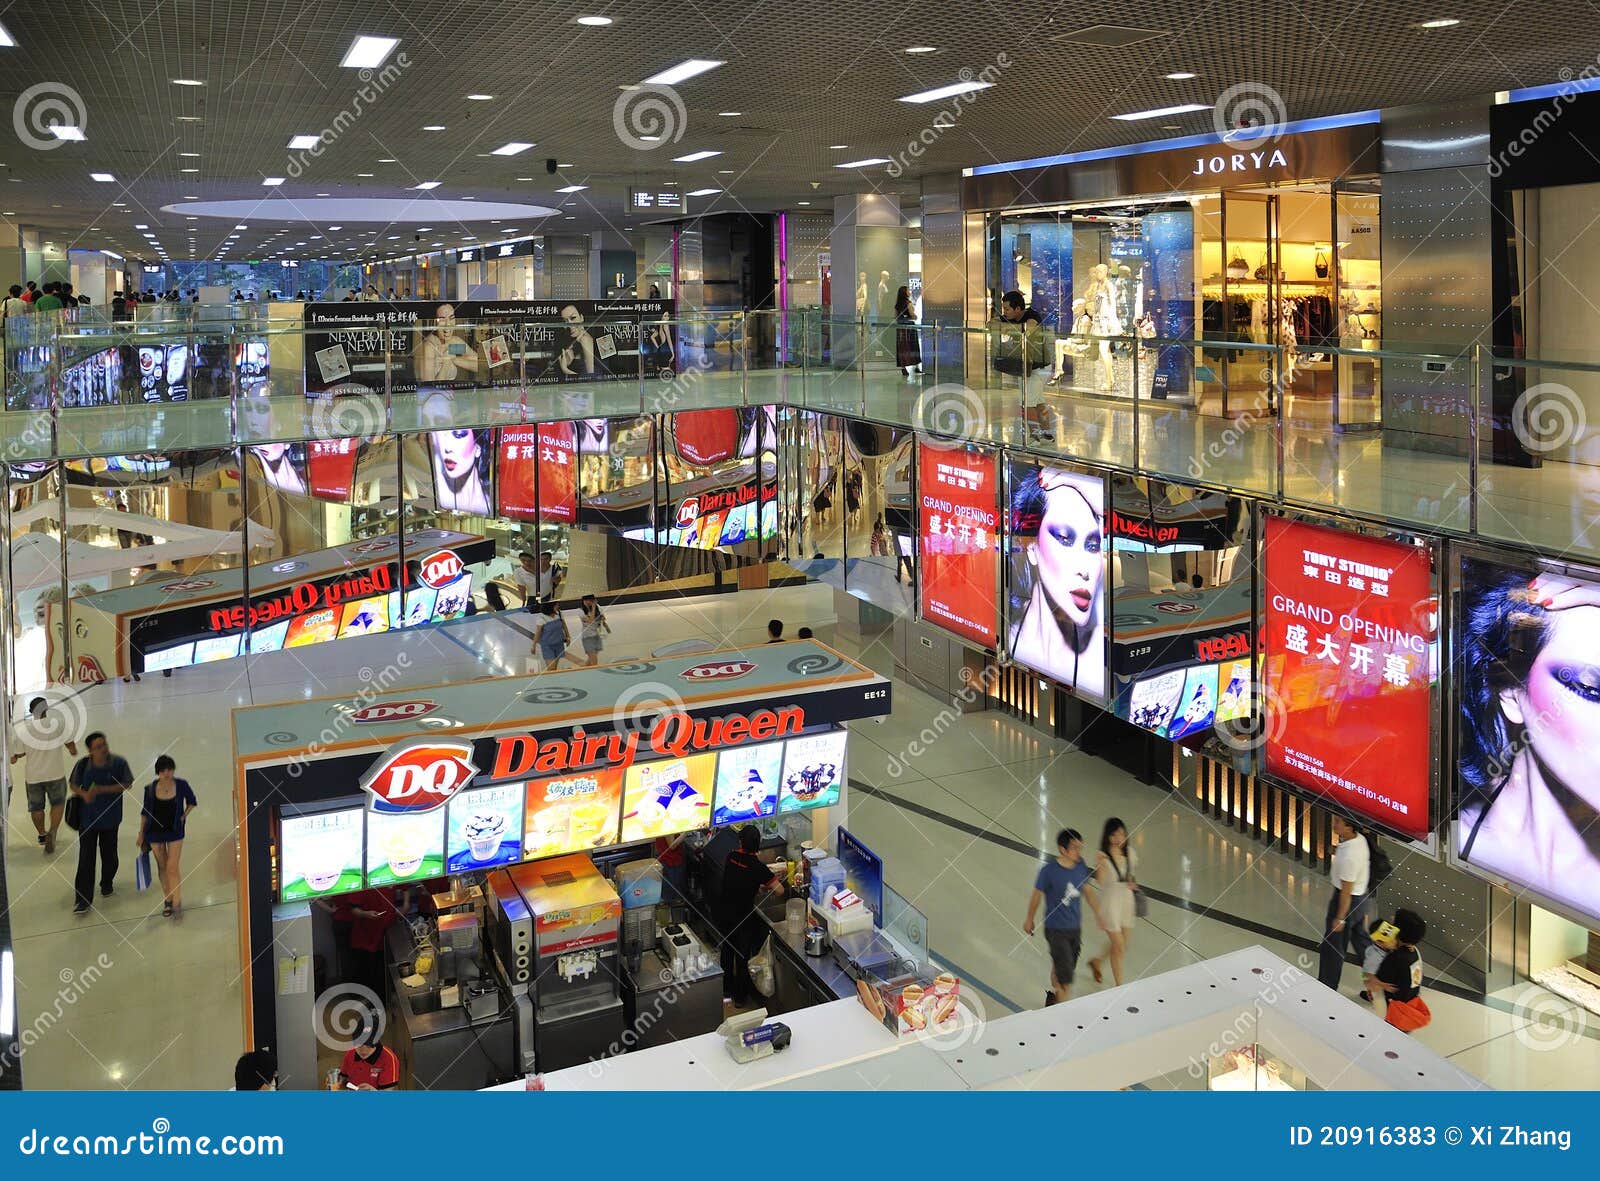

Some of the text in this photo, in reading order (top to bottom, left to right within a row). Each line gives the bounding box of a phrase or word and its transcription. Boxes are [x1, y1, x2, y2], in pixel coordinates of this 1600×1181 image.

[1192, 149, 1287, 175] JORYA
[376, 312, 418, 323] 玛花纤体
[328, 330, 358, 342] NEW
[347, 339, 407, 352] NEW LFE
[923, 496, 994, 526] GRAND OPENING
[930, 514, 987, 549] 盛大开幕
[1303, 550, 1389, 581] TONY STUDIO
[1272, 595, 1425, 653] GRAND OPENING
[1285, 624, 1410, 687] 盛大开幕
[864, 690, 886, 700] EE12
[365, 703, 426, 719] DQ
[492, 729, 641, 780] Dairy
[650, 706, 805, 758] Queen
[386, 758, 459, 799] DQ
